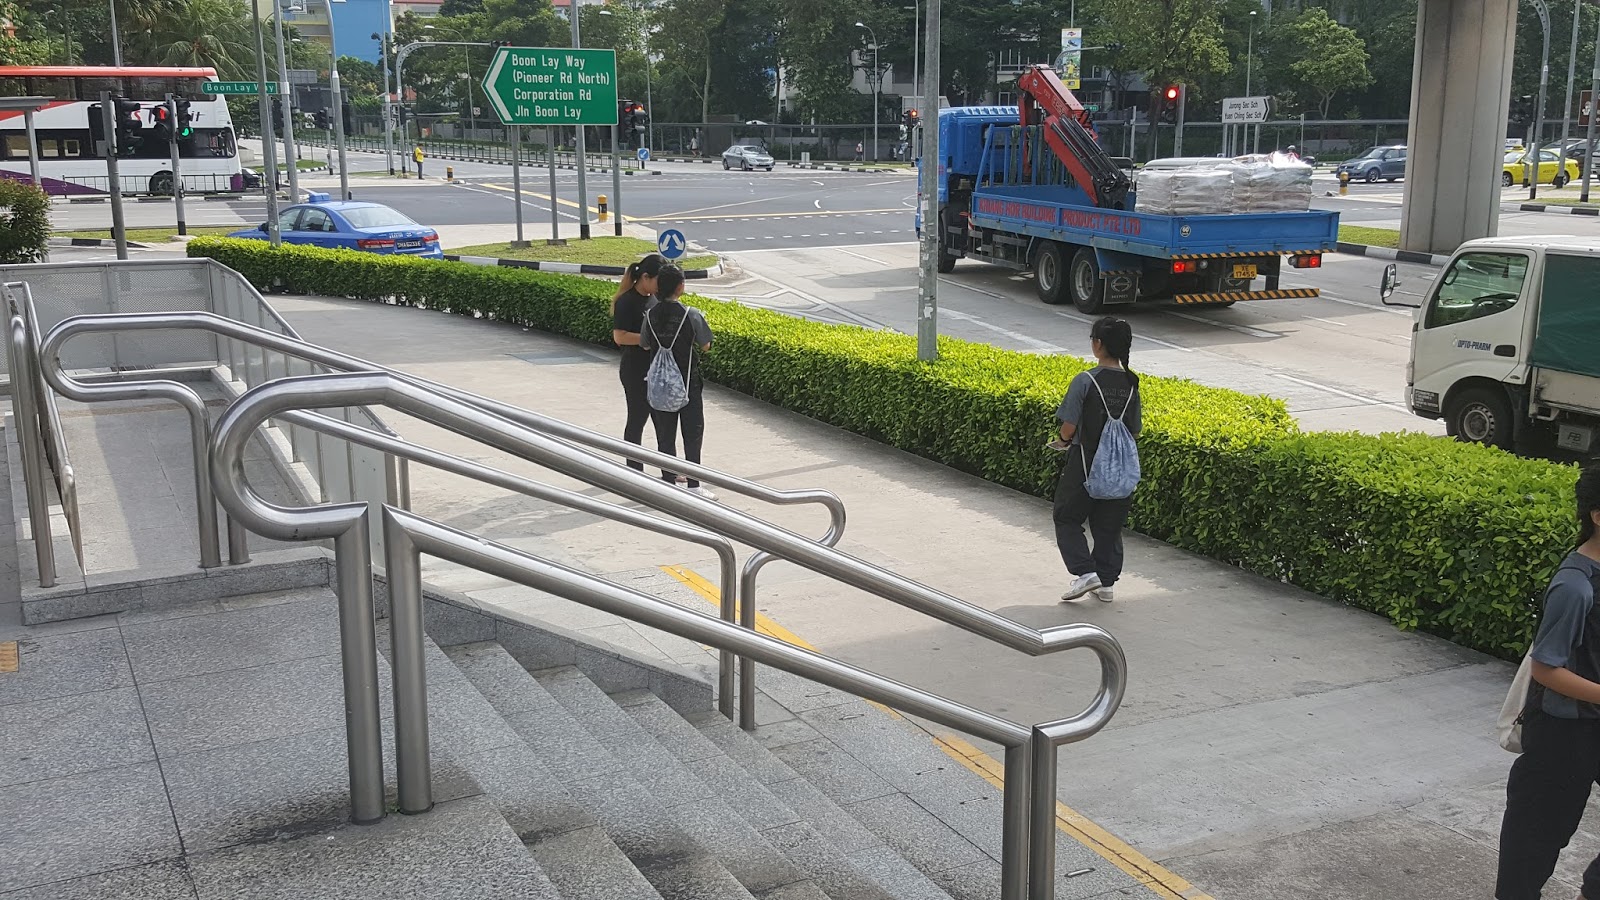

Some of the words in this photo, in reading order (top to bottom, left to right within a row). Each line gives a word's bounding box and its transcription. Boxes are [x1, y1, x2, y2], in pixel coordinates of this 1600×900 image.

[512, 53, 536, 67] Boon
[541, 54, 560, 70] Lay
[565, 55, 585, 70] Way
[512, 69, 554, 84] (Pioneer
[560, 71, 573, 84] Rd
[578, 72, 610, 85] North)
[206, 83, 232, 92] Boon
[234, 83, 251, 93] Lay
[513, 88, 574, 103] Corporation
[579, 89, 592, 101] Rd
[515, 105, 529, 117] Jln
[535, 105, 559, 117] Boon
[564, 106, 581, 120] Lay
[1228, 101, 1241, 111] Jurong
[1242, 101, 1250, 109] Sec
[1250, 100, 1259, 109] Sch
[1225, 112, 1233, 120] Yuan
[1233, 111, 1245, 121] Ching
[1245, 111, 1253, 119] Sec
[1254, 111, 1262, 119] Sch
[1021, 204, 1056, 224] BUILDING
[1062, 209, 1100, 229] PRODUCT
[1103, 214, 1120, 233] PTE
[1123, 217, 1141, 236] LTD
[1457, 339, 1492, 351] OPTO-PHARM
